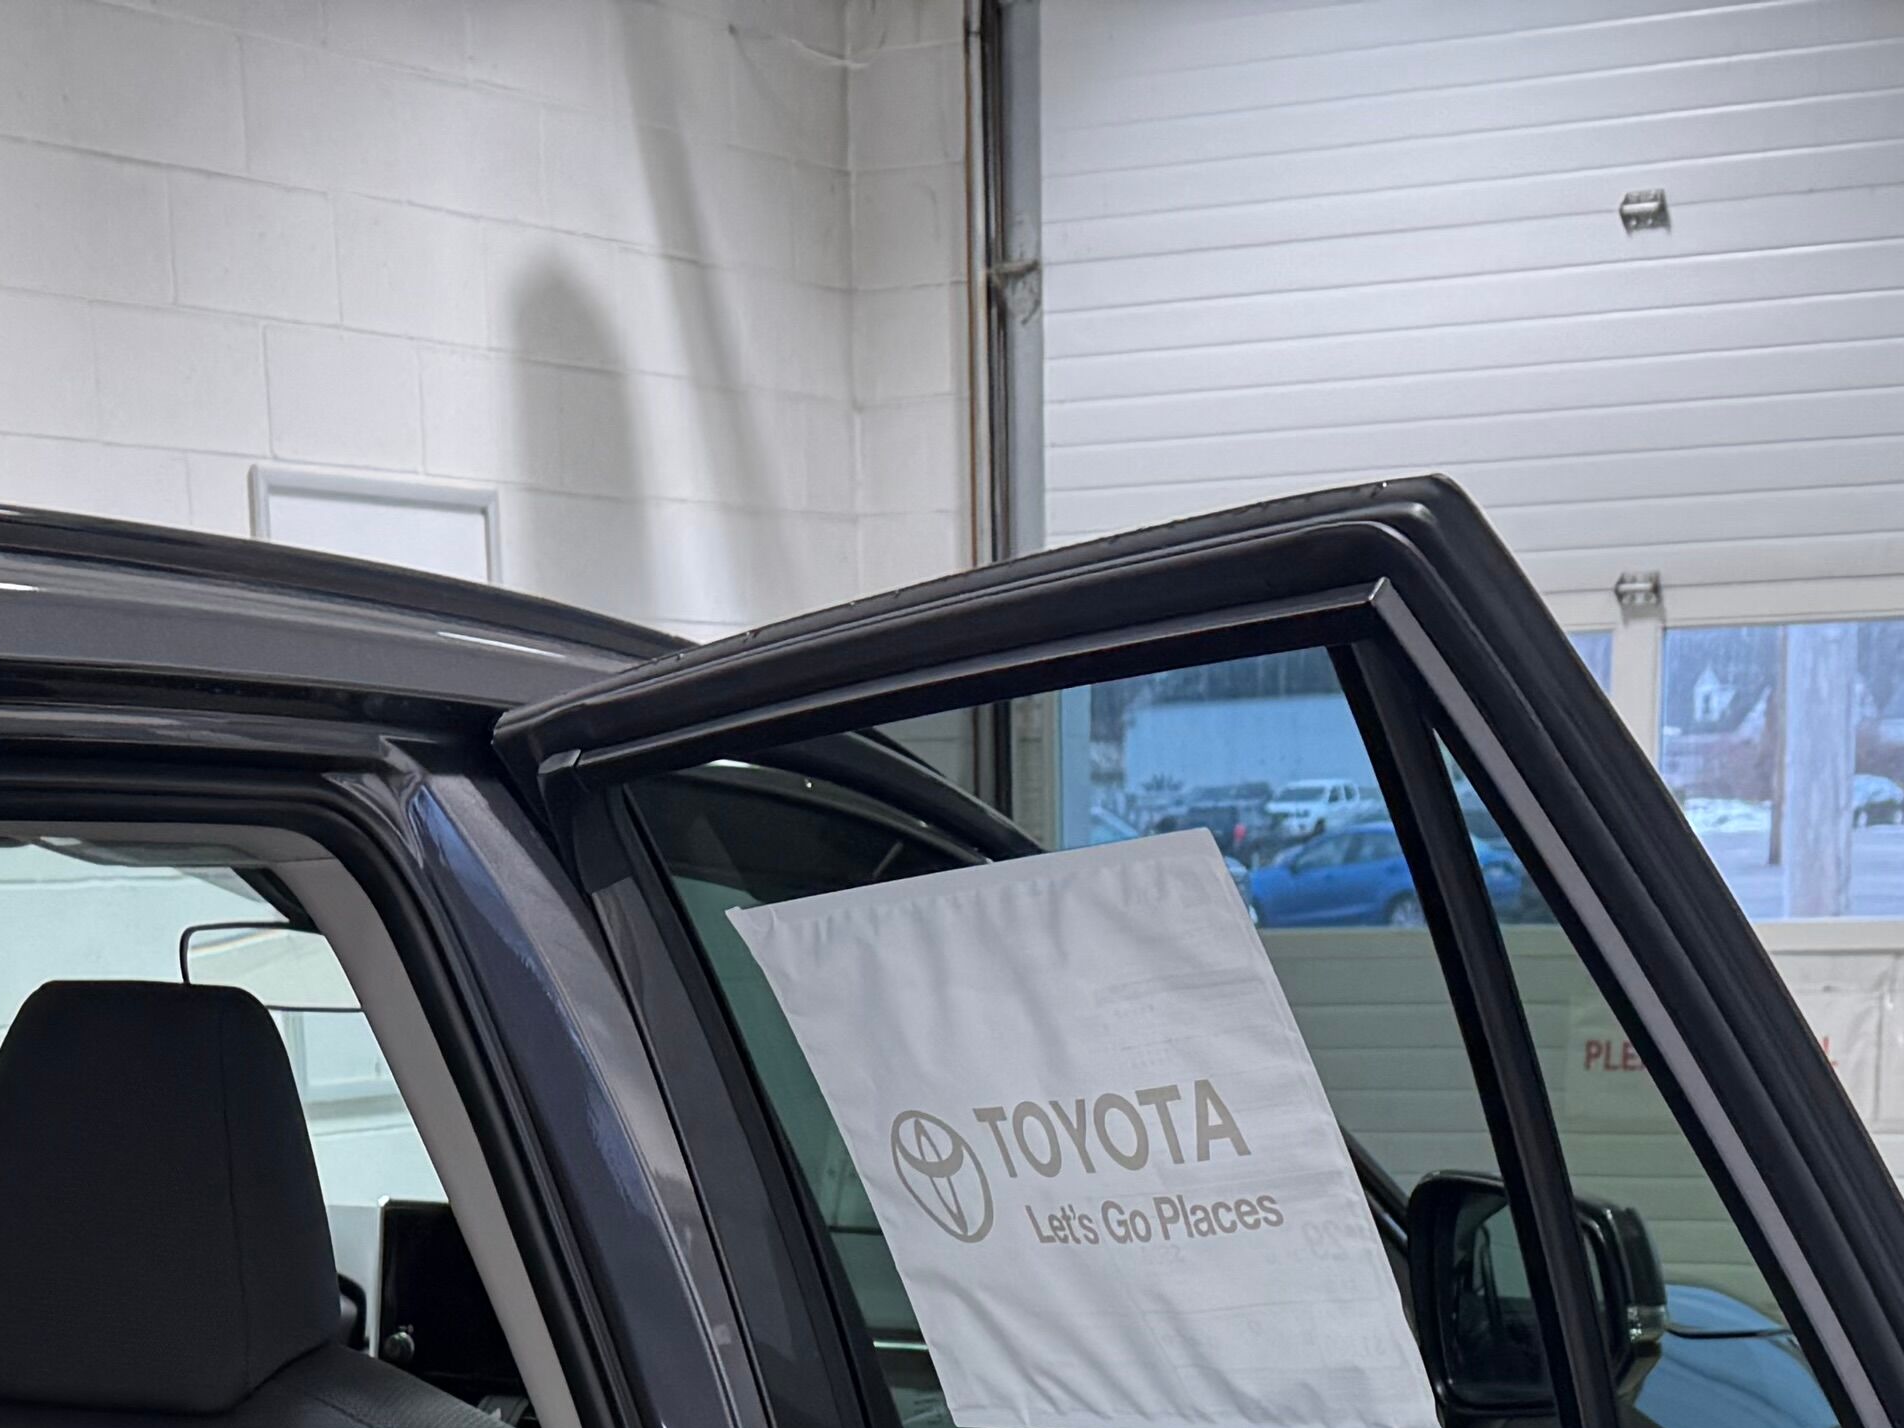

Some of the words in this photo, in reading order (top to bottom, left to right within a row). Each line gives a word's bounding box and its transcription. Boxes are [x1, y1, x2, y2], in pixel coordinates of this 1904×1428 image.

[1584, 1038, 1645, 1071] PLE
[973, 1079, 1251, 1178] TOYOTA
[1026, 1204, 1099, 1248] Let's
[1102, 1201, 1152, 1245] Go
[1153, 1194, 1284, 1240] Places
